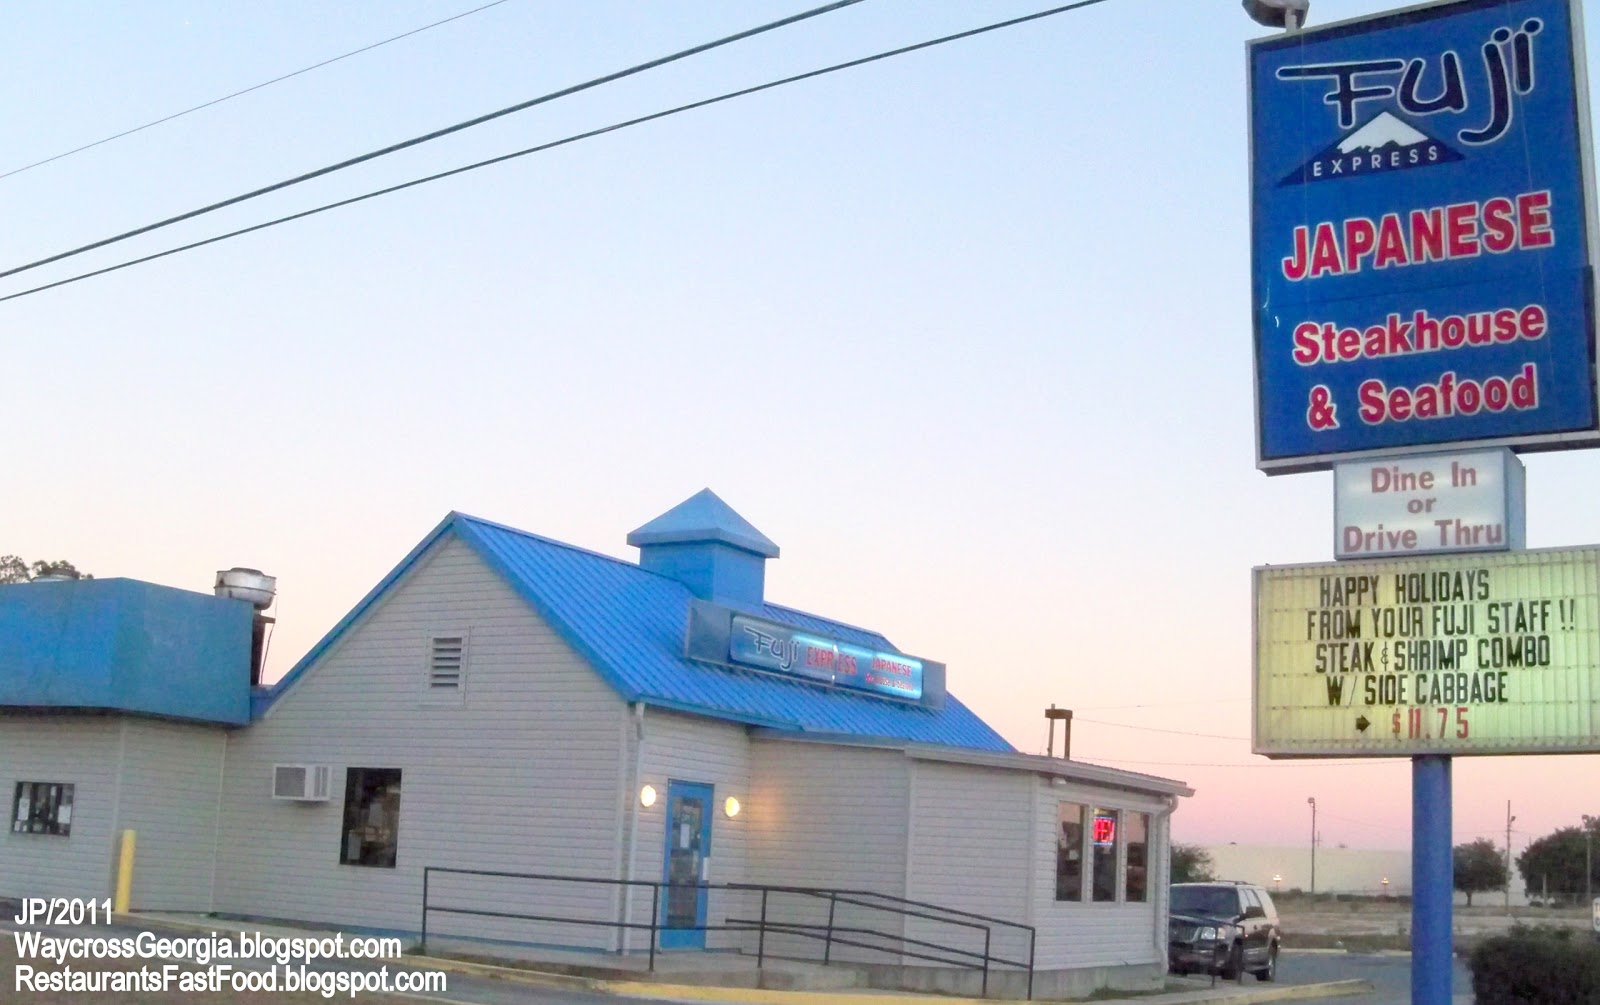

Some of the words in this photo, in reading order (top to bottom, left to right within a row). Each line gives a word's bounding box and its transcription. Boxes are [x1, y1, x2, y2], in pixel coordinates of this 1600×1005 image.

[1312, 145, 1438, 177] EXPRESS
[1282, 190, 1556, 281] JAPANESE
[1292, 304, 1549, 366] Steakhouse
[1306, 384, 1340, 431] &
[1358, 362, 1541, 425] Seafood
[1371, 467, 1435, 493] Dine
[1451, 461, 1477, 487] In
[1407, 497, 1437, 514] or
[1343, 524, 1418, 552] Drive
[1434, 518, 1503, 547] Thru
[1319, 574, 1380, 607] HAPPY
[1395, 569, 1490, 605] HOLIDAYS
[1307, 608, 1361, 641] FROM
[1371, 606, 1424, 638] YOUR
[1431, 605, 1474, 636] FUJI
[804, 646, 858, 676] EXPRESS
[872, 657, 912, 678] JAPANESE
[1315, 641, 1375, 674] STEAK
[1393, 638, 1468, 672] SHRIMP
[1477, 635, 1550, 668] COMBO
[1364, 674, 1408, 706] SIDE
[1415, 671, 1509, 705] CABBAGE
